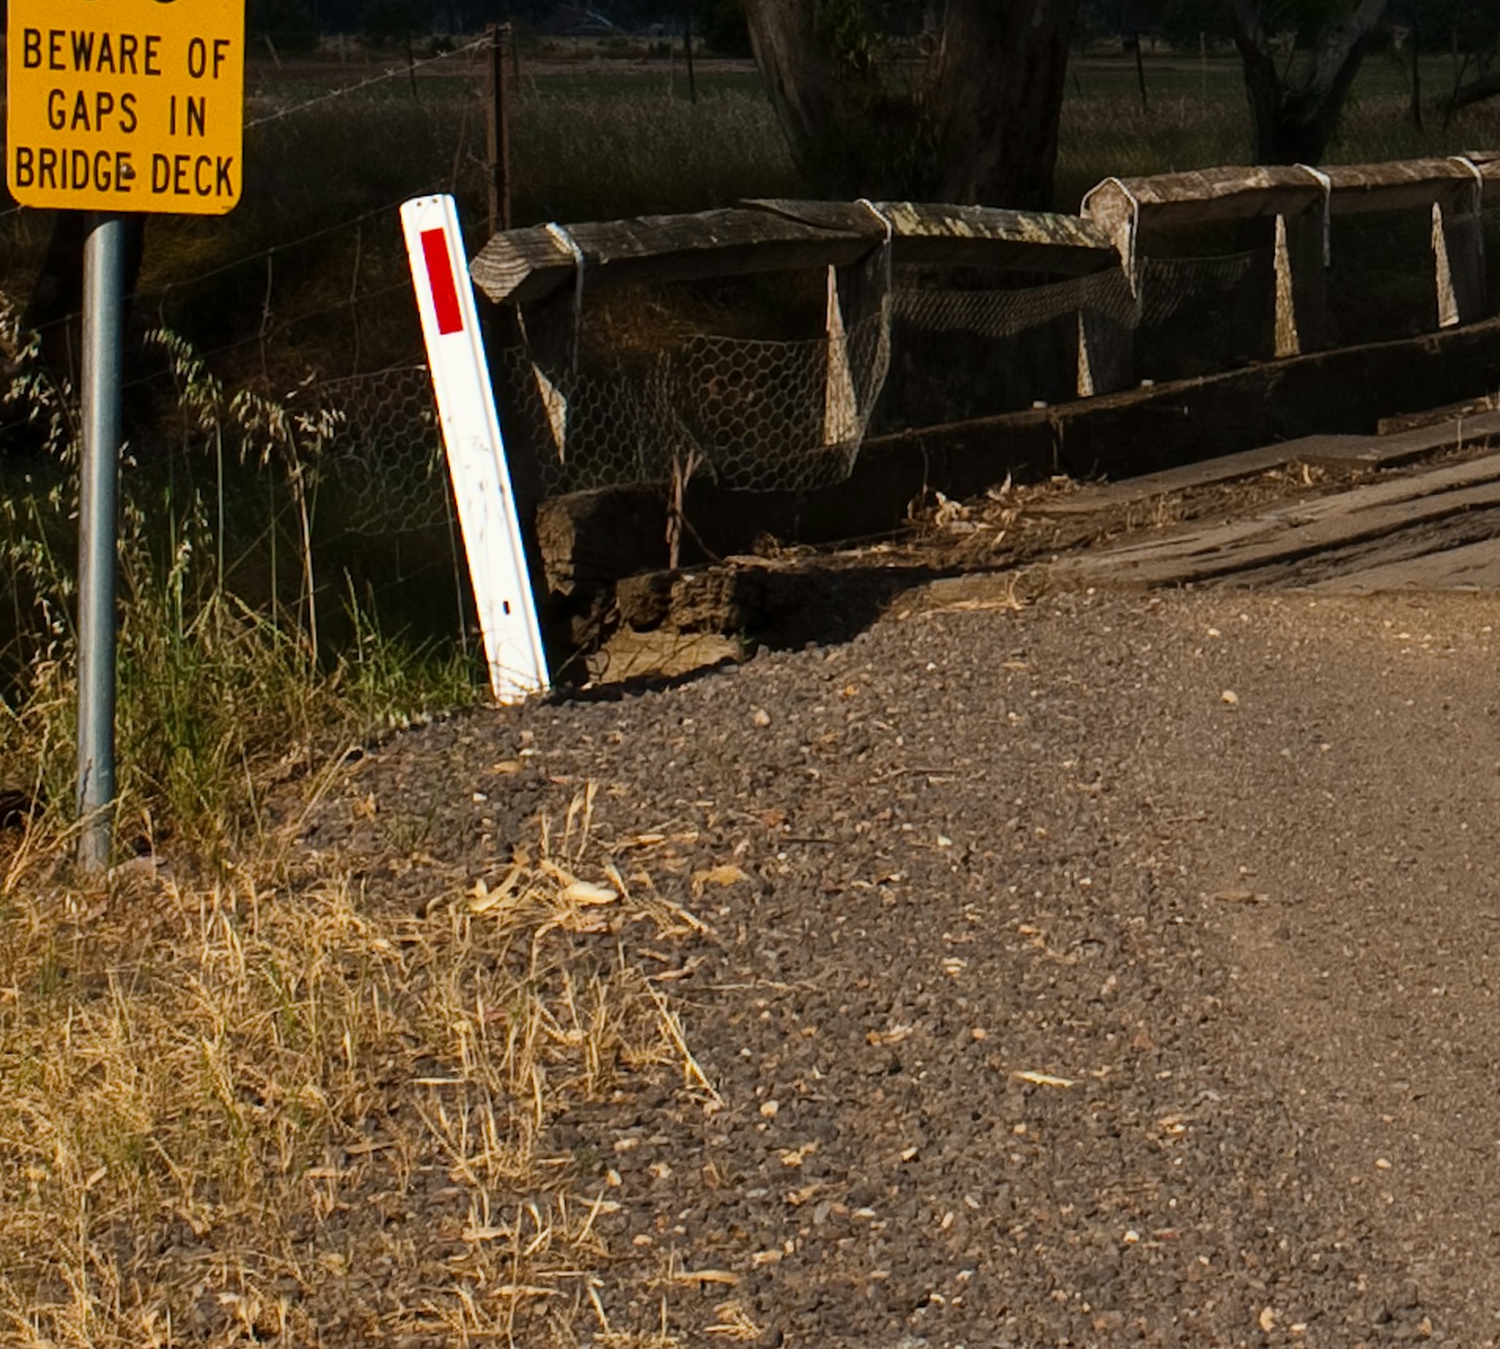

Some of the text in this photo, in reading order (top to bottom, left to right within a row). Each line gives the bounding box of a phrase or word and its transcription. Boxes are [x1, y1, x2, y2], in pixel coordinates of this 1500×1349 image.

[23, 28, 230, 79] BEWARE OF
[48, 88, 206, 137] GAPS IN
[16, 147, 234, 197] BRIDGE DECK
